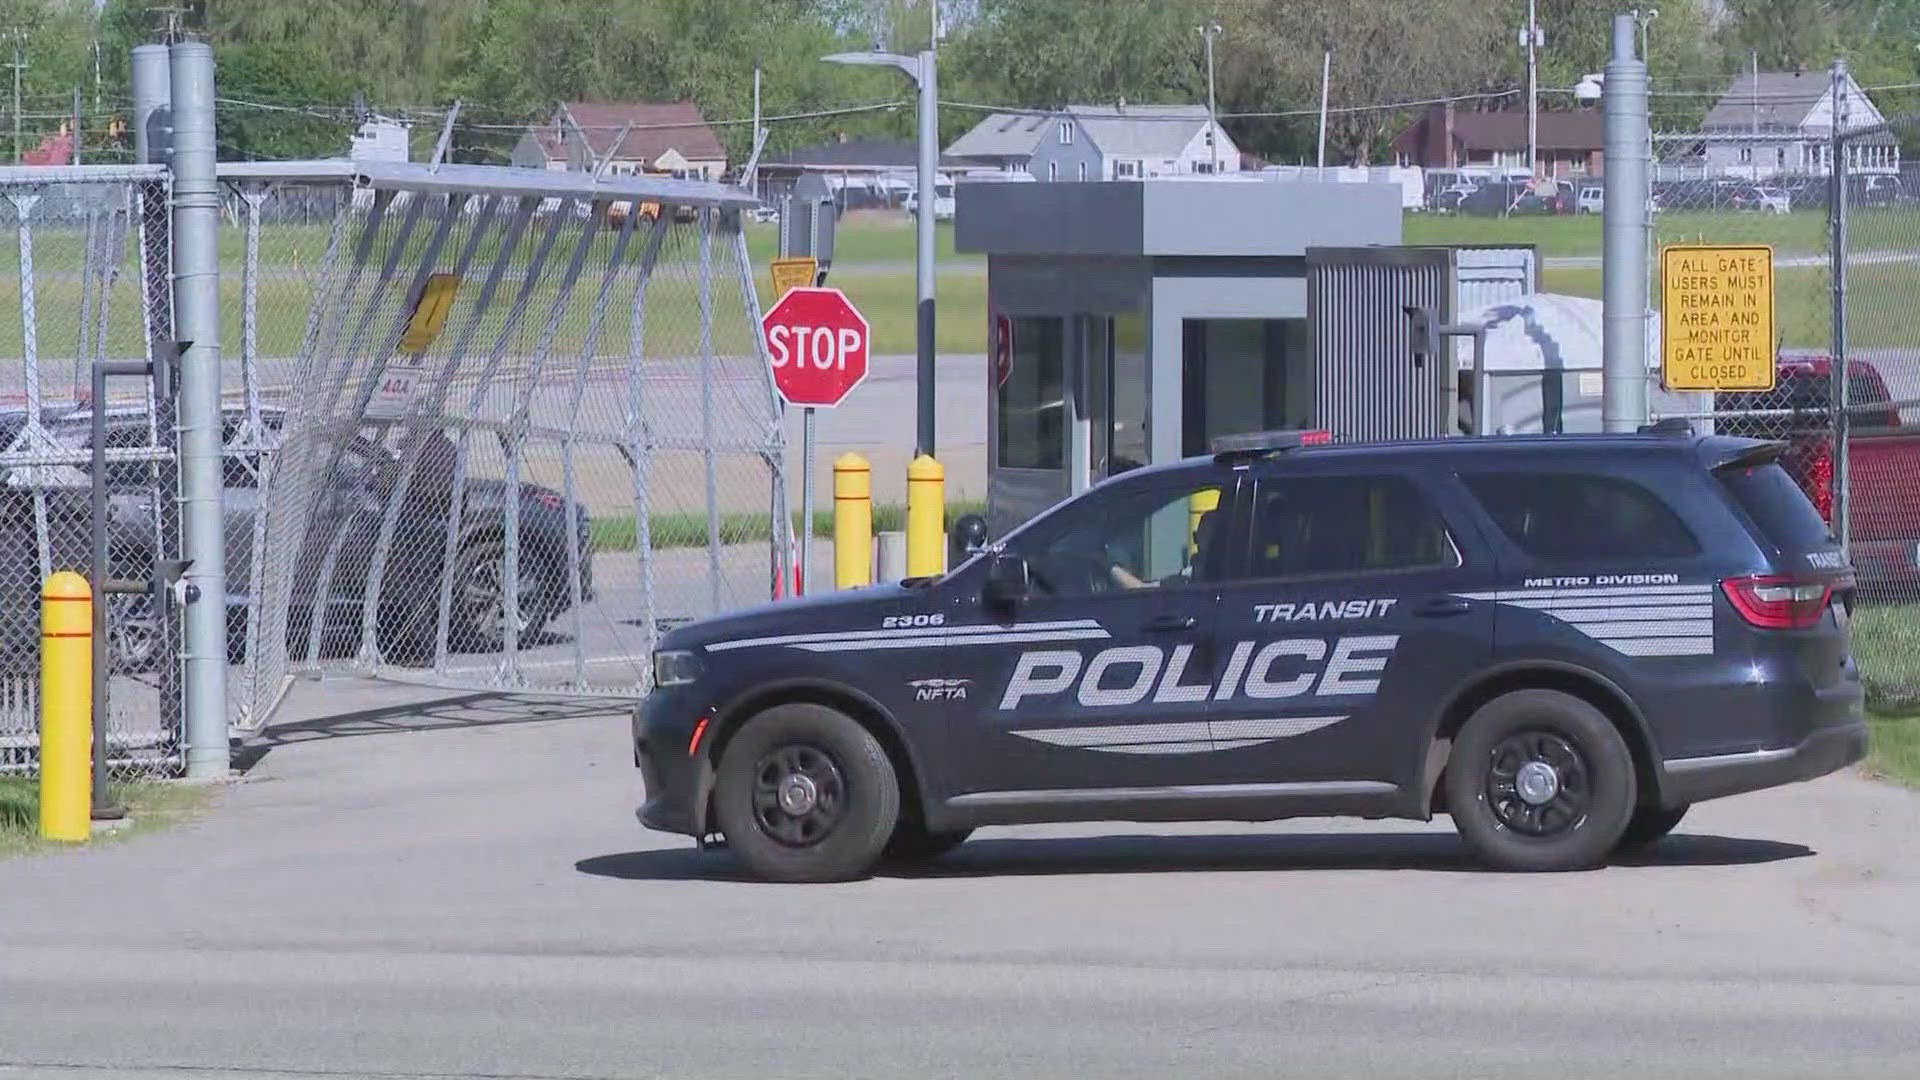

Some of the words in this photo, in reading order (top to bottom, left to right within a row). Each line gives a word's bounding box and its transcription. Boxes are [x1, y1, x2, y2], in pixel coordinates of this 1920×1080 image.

[1681, 258, 1708, 273] ALL
[1718, 258, 1756, 272] GATE
[1671, 276, 1718, 290] USERS
[1728, 275, 1765, 290] MUST
[1681, 294, 1734, 308] REMAIN
[1743, 294, 1757, 307] IN
[1680, 312, 1719, 326] AREA
[1731, 312, 1760, 325] AND
[1688, 329, 1750, 344] MONITOR
[769, 324, 861, 371] STOP
[1675, 347, 1713, 362] GATE
[1723, 347, 1761, 361] UNTIL
[1690, 365, 1747, 380] CLOSED
[1524, 577, 1589, 588] METRO
[1596, 573, 1678, 585] DIVISION
[1253, 599, 1398, 623] TRANSIT
[882, 613, 945, 629] 2306
[999, 634, 1400, 710] POLICE
[916, 687, 967, 701] NFTA
